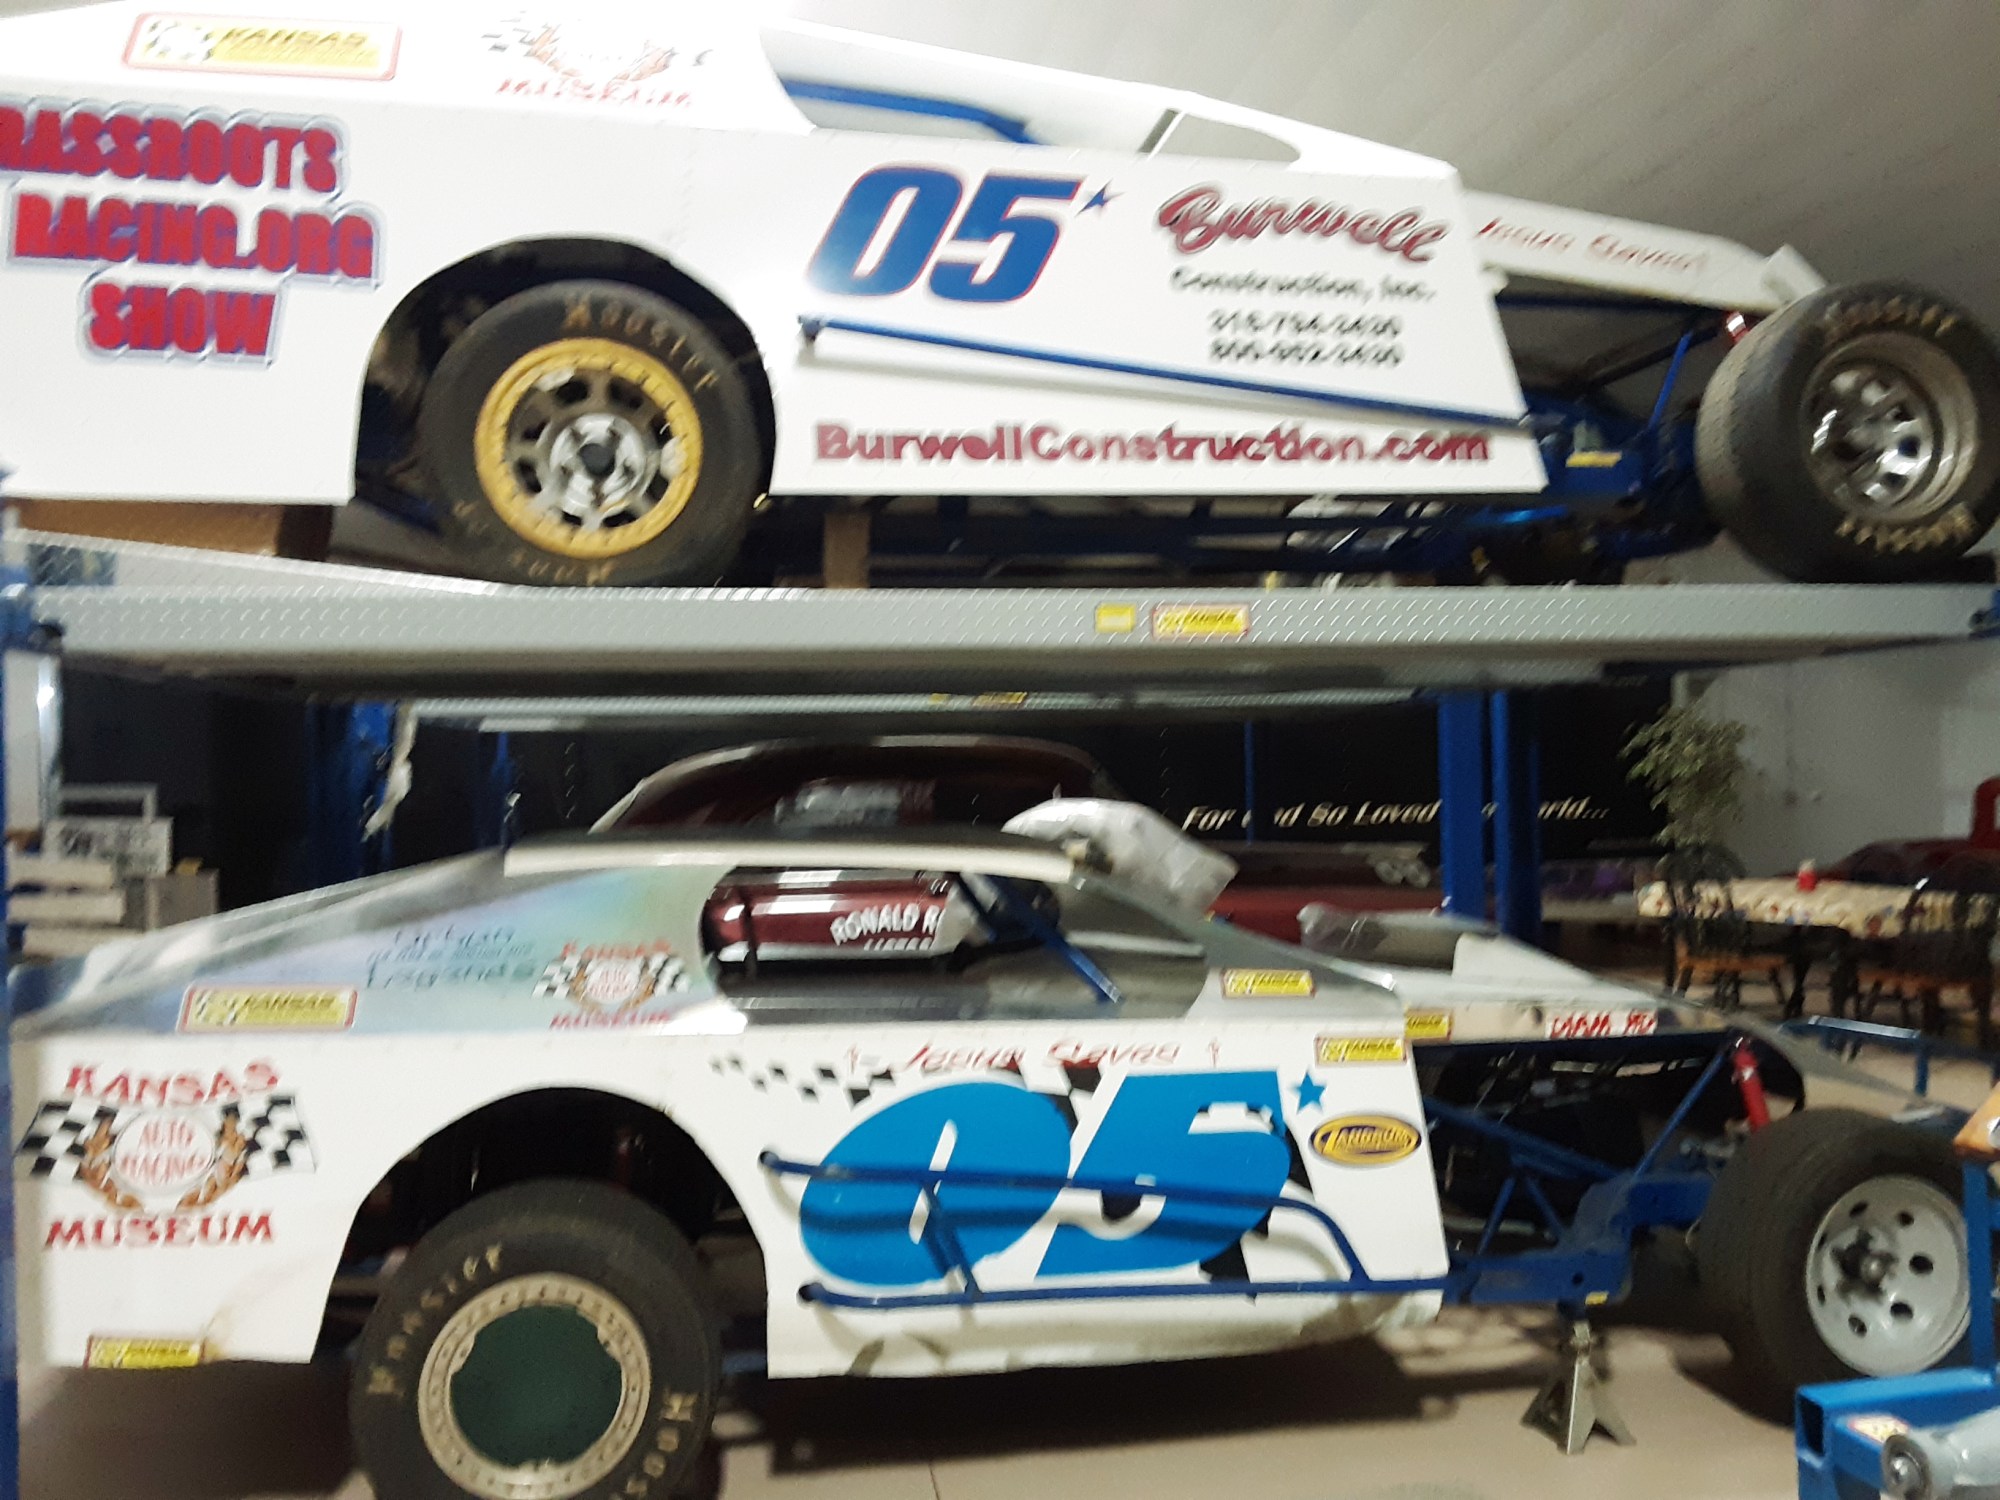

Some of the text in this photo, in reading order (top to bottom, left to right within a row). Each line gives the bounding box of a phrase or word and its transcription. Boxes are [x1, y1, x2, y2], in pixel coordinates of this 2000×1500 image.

[14, 193, 376, 280] RACING.ORG
[805, 160, 1089, 304] 05
[1157, 184, 1447, 263] Burwell
[1168, 266, 1437, 304] Construction, Inc.
[88, 281, 278, 356] SHOW
[814, 419, 1491, 465] BurwellConstruction.com
[1179, 804, 1238, 832] For
[1305, 800, 1350, 828] So
[1351, 797, 1444, 826] Loved
[829, 901, 921, 947] RONALD
[61, 1058, 281, 1108] KANSAS
[138, 1117, 196, 1150] AUTO
[799, 1070, 1290, 1287] 05
[44, 1209, 276, 1252] MUSEUM
